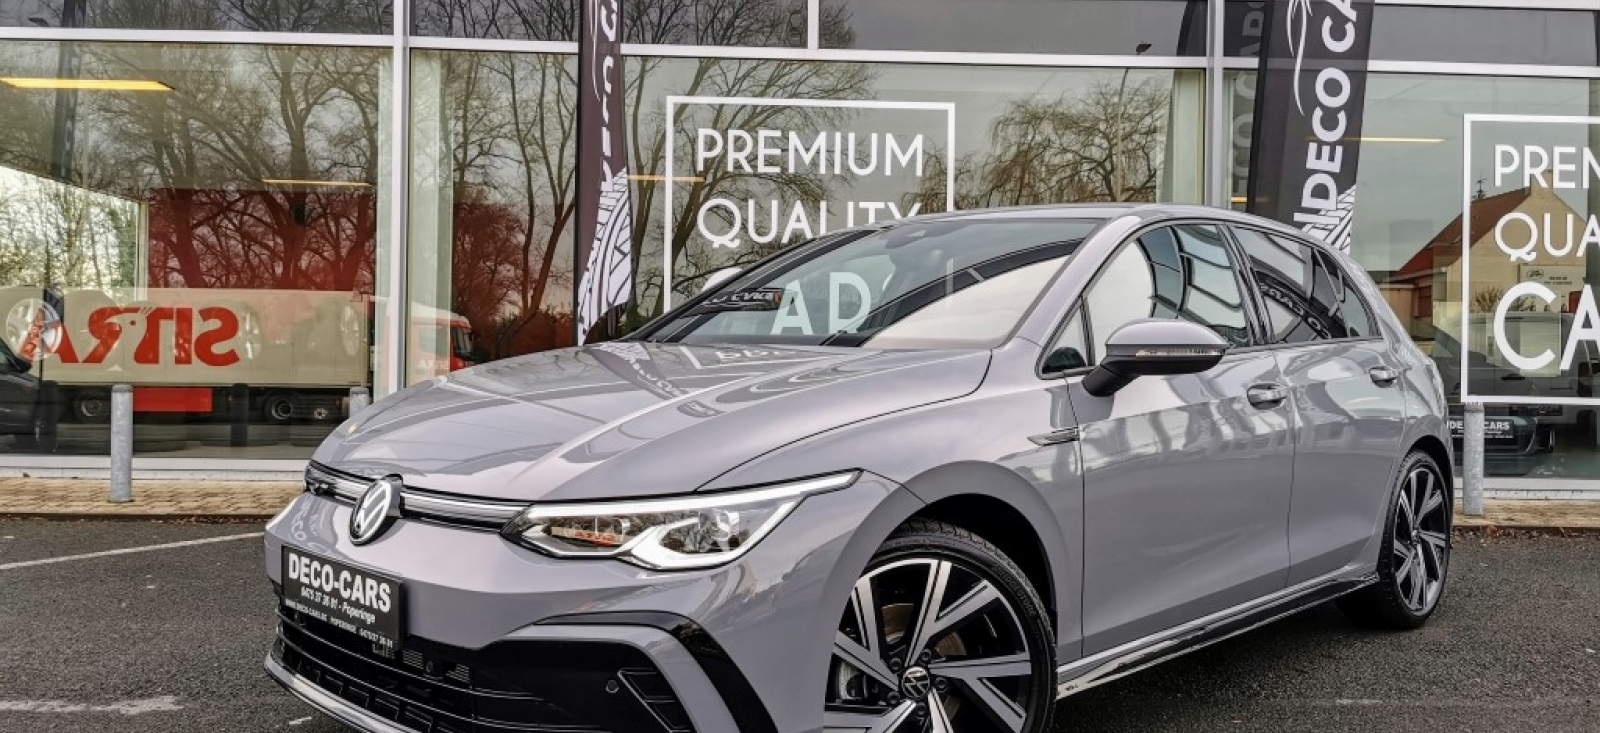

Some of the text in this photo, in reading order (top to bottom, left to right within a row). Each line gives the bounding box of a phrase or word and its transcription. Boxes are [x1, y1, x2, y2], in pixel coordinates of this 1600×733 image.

[697, 128, 924, 177] PREMIUM
[1494, 212, 1600, 262] QUA
[1493, 281, 1600, 371] CA
[288, 552, 392, 613] DECO-CARS
